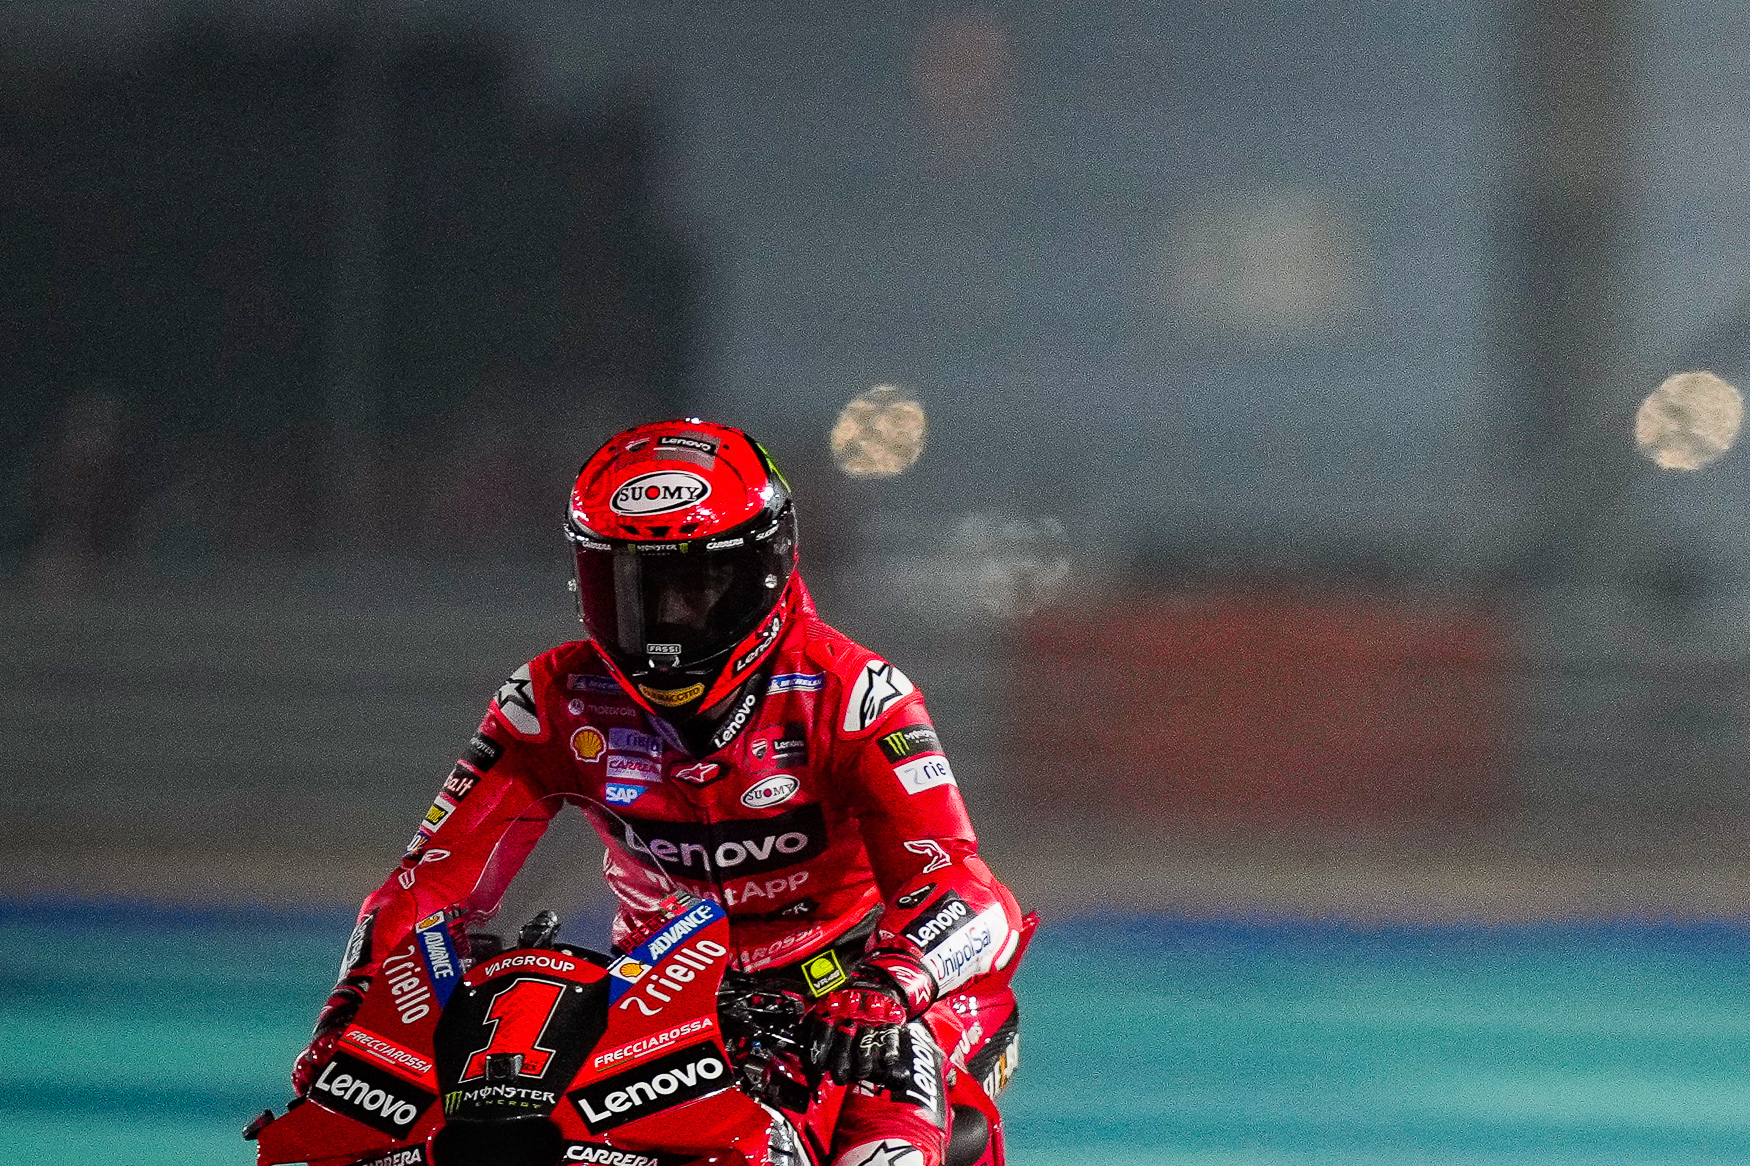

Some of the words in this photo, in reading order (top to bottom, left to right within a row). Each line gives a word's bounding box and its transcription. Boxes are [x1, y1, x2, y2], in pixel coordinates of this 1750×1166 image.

[660, 436, 712, 452] Lenovo
[619, 485, 701, 502] SUOMY
[706, 536, 745, 550] CARRERA
[714, 694, 756, 749] Lenovo
[605, 786, 638, 803] SAP
[747, 783, 796, 802] SUOMY
[648, 905, 714, 961] ADVANCE
[905, 900, 967, 948] Lenovo
[423, 931, 454, 979] ADVANCE
[645, 939, 728, 1003] riello
[930, 921, 992, 981] UnipolSai
[346, 1030, 433, 1075] FRECCIAROSSA
[458, 977, 567, 1084] 1
[593, 1017, 714, 1069] FRECCIAROSSA
[314, 1061, 418, 1125] Lenovo
[577, 1057, 724, 1124] Lenovo
